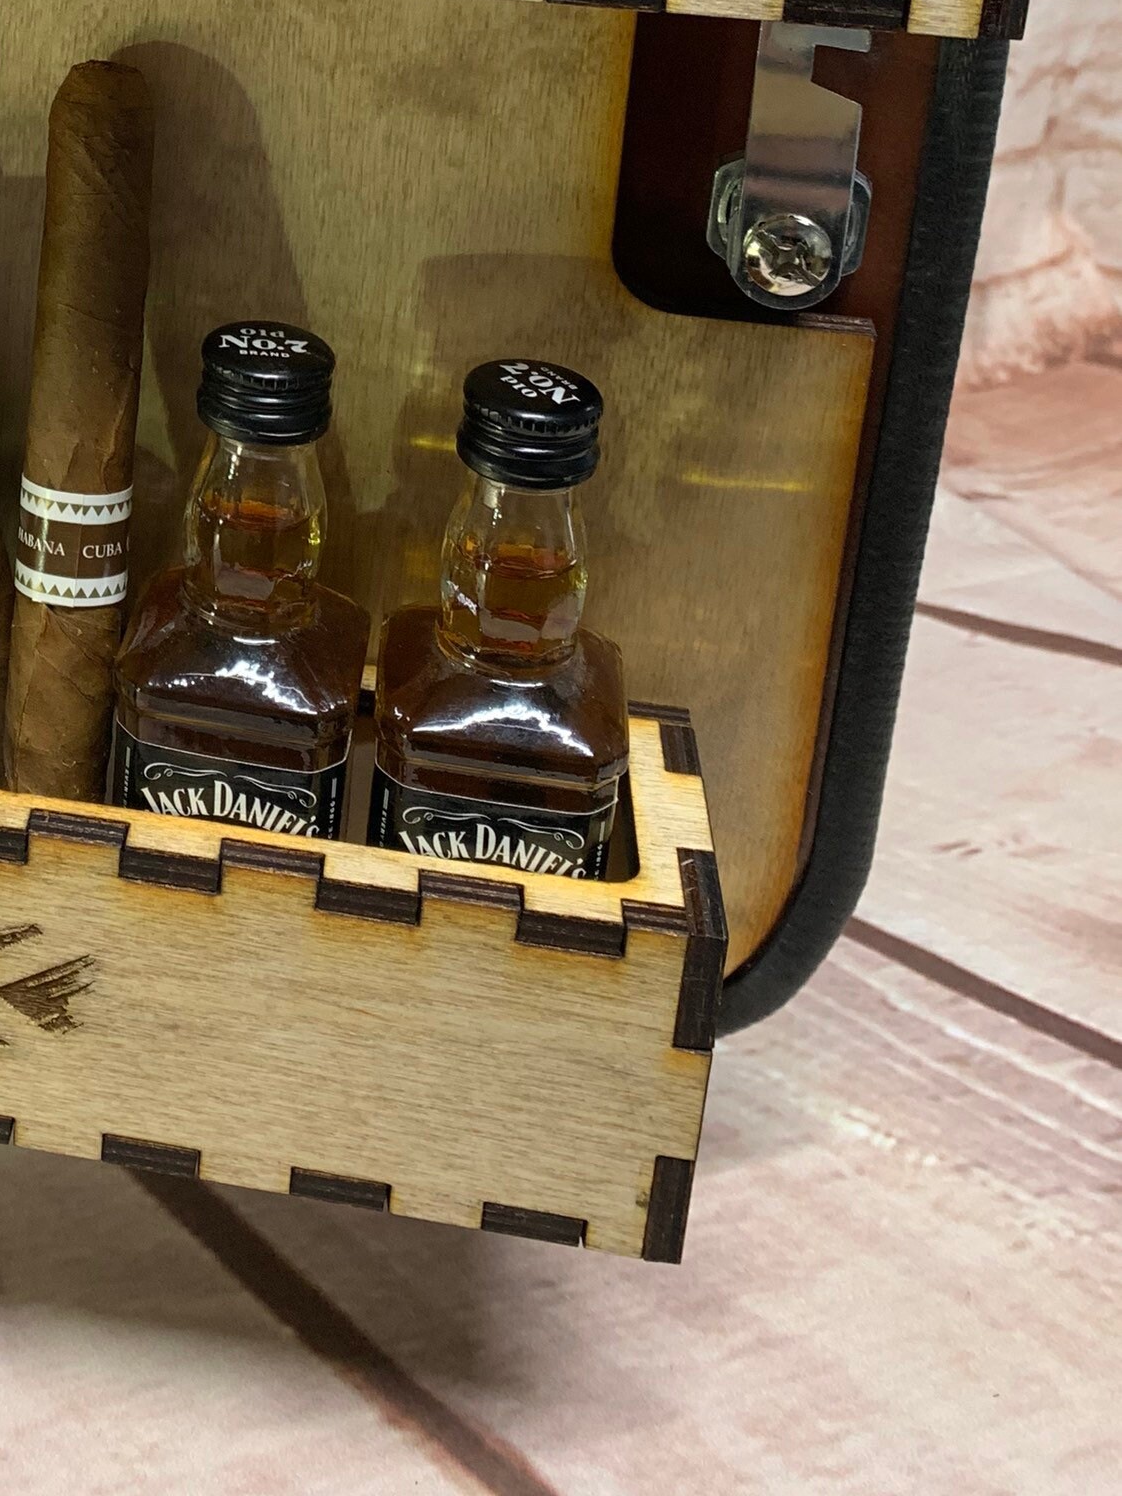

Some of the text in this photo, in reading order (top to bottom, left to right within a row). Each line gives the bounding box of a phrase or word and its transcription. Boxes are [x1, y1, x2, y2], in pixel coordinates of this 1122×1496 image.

[218, 335, 309, 353] No.7
[239, 328, 285, 338] Old
[239, 349, 290, 358] BRAND
[500, 375, 538, 398] Old
[540, 366, 578, 390] BRAND
[18, 525, 123, 559] HABANA CUBA
[140, 786, 209, 817] JACK
[398, 830, 470, 860] JACK
